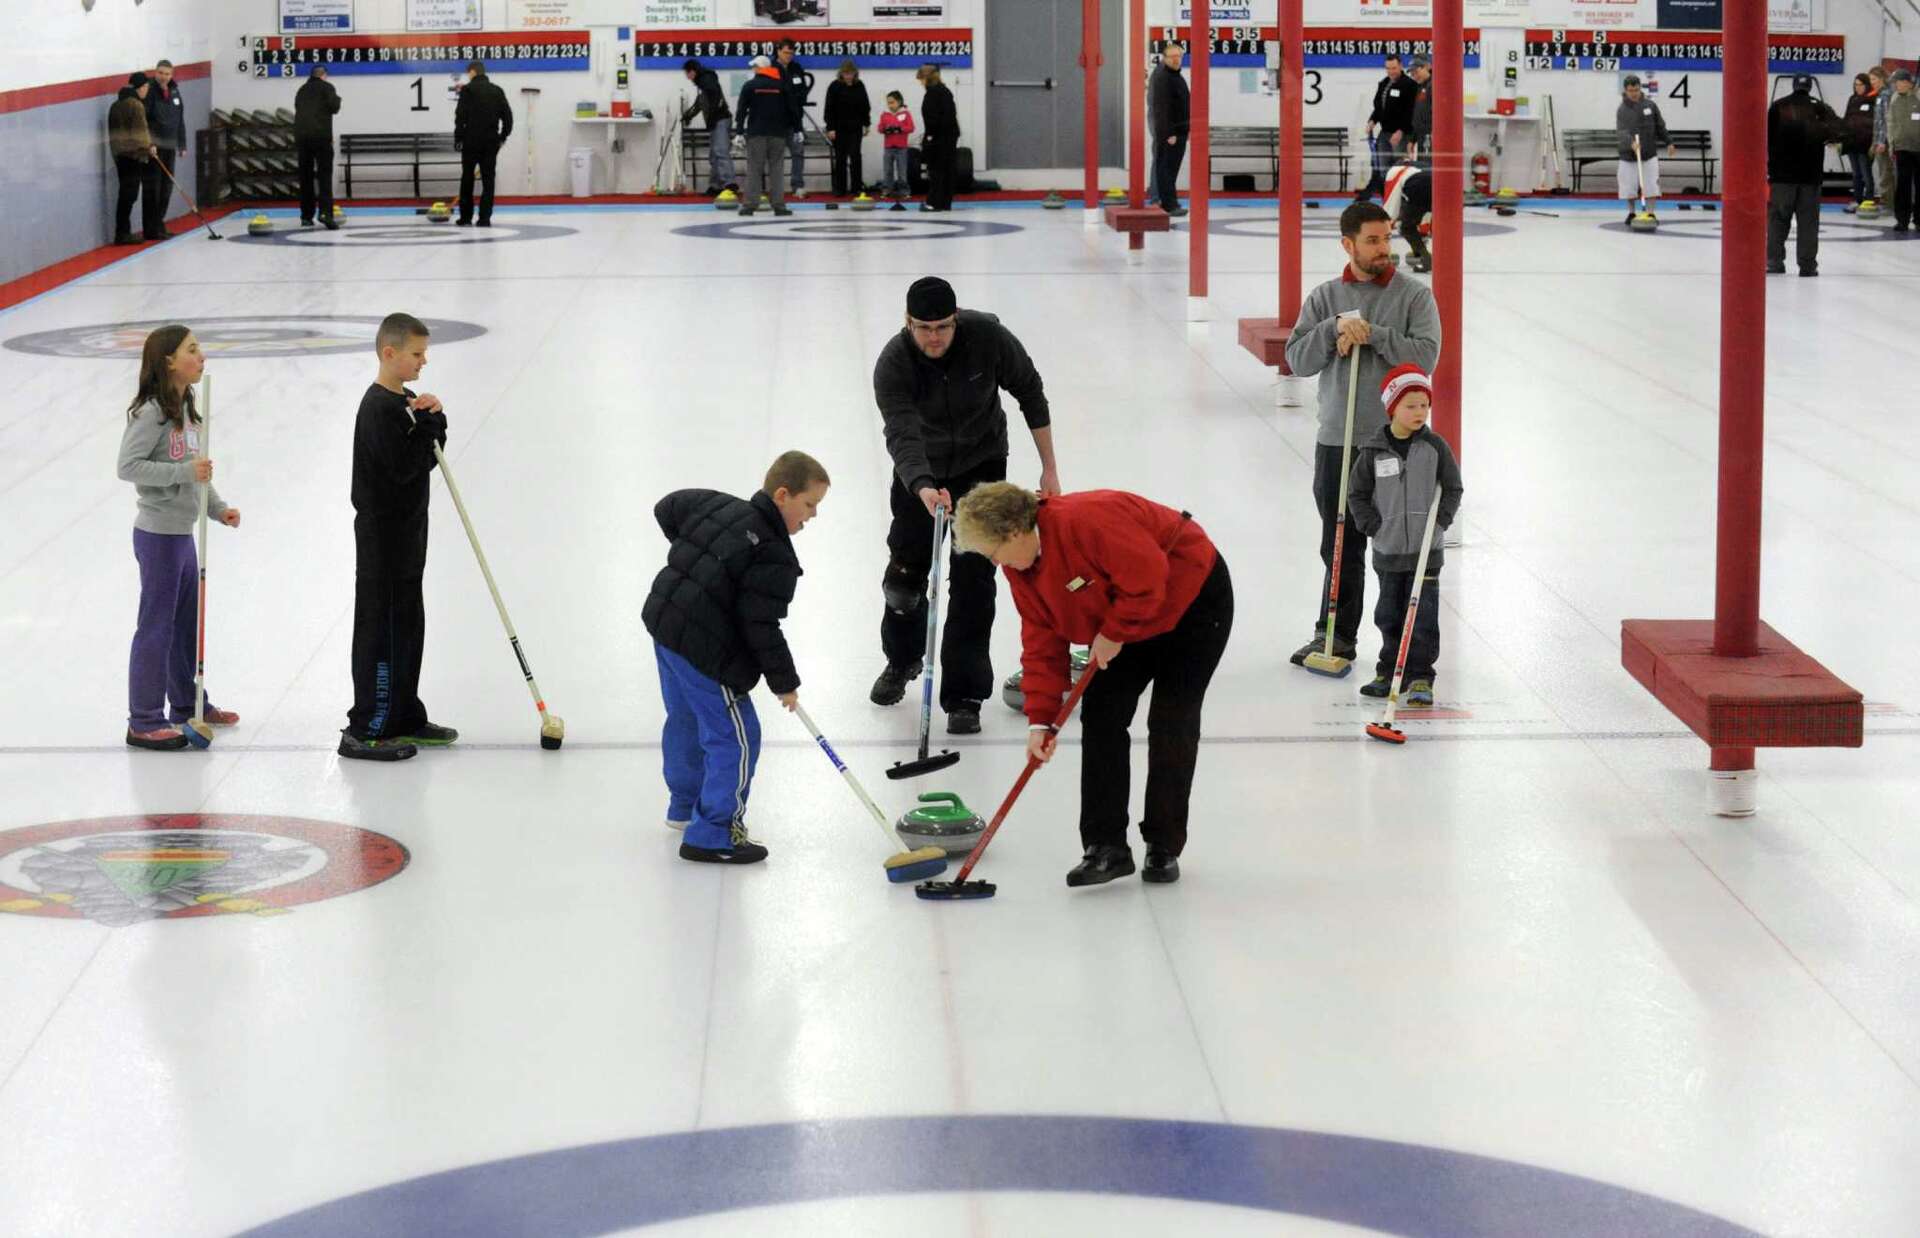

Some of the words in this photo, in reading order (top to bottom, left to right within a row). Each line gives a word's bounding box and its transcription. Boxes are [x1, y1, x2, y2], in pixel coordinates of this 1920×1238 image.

[1167, 28, 1173, 39] 1
[1209, 28, 1217, 39] 2
[1235, 28, 1244, 39] 3
[1250, 28, 1258, 39] 5
[1554, 31, 1564, 42] 3
[1595, 31, 1604, 42] 5
[240, 36, 247, 47] 1
[256, 39, 265, 49] 4
[285, 38, 293, 49] 5
[1154, 40, 1158, 53] 1
[1222, 40, 1229, 53] 6
[1237, 40, 1242, 53] 7
[1250, 40, 1256, 53] 8
[1303, 40, 1313, 54] 12
[1317, 41, 1328, 54] 13
[1330, 41, 1342, 54] 14
[1344, 41, 1354, 54] 15
[1358, 41, 1370, 54] 16
[1372, 41, 1382, 54] 17
[1386, 41, 1397, 54] 18
[1399, 41, 1410, 54] 19
[1414, 41, 1426, 54] 20
[1468, 41, 1479, 54] 24
[259, 51, 262, 62] 1
[272, 51, 278, 62] 2
[285, 50, 291, 62] 3
[298, 50, 304, 62] 4
[313, 50, 319, 62] 5
[327, 49, 333, 61] 6
[341, 49, 347, 61] 7
[354, 49, 360, 61] 8
[368, 49, 374, 61] 9
[379, 48, 390, 60] 10
[394, 48, 403, 60] 11
[407, 48, 417, 60] 12
[421, 47, 432, 60] 13
[435, 47, 446, 59] 14
[449, 47, 459, 59] 15
[462, 46, 473, 59] 16
[476, 46, 486, 59] 17
[490, 46, 502, 58] 18
[504, 46, 515, 58] 19
[518, 45, 531, 58] 20
[533, 45, 544, 58] 21
[546, 45, 558, 57] 22
[561, 44, 573, 57] 23
[575, 44, 588, 57] 24
[639, 43, 644, 56] 1
[653, 43, 660, 56] 2
[667, 43, 674, 56] 3
[680, 43, 687, 56] 4
[695, 43, 701, 56] 5
[709, 43, 716, 56] 6
[723, 43, 730, 56] 7
[737, 43, 744, 56] 8
[751, 43, 758, 56] 9
[762, 43, 773, 56] 10
[804, 43, 814, 55] 13
[818, 43, 829, 55] 14
[832, 43, 843, 55] 15
[846, 43, 857, 55] 16
[860, 42, 871, 55] 17
[874, 42, 886, 55] 18
[889, 42, 900, 55] 19
[903, 42, 915, 55] 20
[917, 42, 928, 55] 21
[930, 42, 942, 55] 22
[945, 42, 956, 55] 23
[958, 42, 971, 55] 24
[1528, 43, 1533, 56] 1
[1542, 44, 1548, 56] 2
[1555, 44, 1561, 56] 3
[1570, 44, 1576, 57] 4
[1583, 44, 1589, 57] 5
[1596, 45, 1602, 57] 6
[1610, 45, 1616, 57] 7
[1623, 45, 1629, 57] 8
[1636, 45, 1642, 58] 9
[1647, 46, 1658, 58] 10
[1662, 46, 1671, 58] 11
[1674, 46, 1684, 58] 12
[1687, 46, 1698, 58] 13
[1700, 46, 1711, 59] 14
[1713, 47, 1723, 59] 15
[1780, 48, 1791, 60] 20
[1793, 48, 1802, 60] 21
[1806, 48, 1816, 60] 22
[1819, 48, 1829, 60] 23
[1832, 49, 1842, 60] 24
[620, 53, 626, 64] 1
[1508, 50, 1518, 62] 8
[238, 61, 248, 73] 6
[1528, 59, 1535, 69] 1
[1540, 59, 1550, 69] 2
[1567, 59, 1577, 69] 4
[1595, 59, 1604, 69] 6
[1608, 59, 1617, 69] 7
[256, 66, 266, 77] 2
[284, 65, 293, 77] 3
[1304, 70, 1323, 105] 3
[1669, 74, 1691, 108] 4
[411, 77, 429, 111] 1
